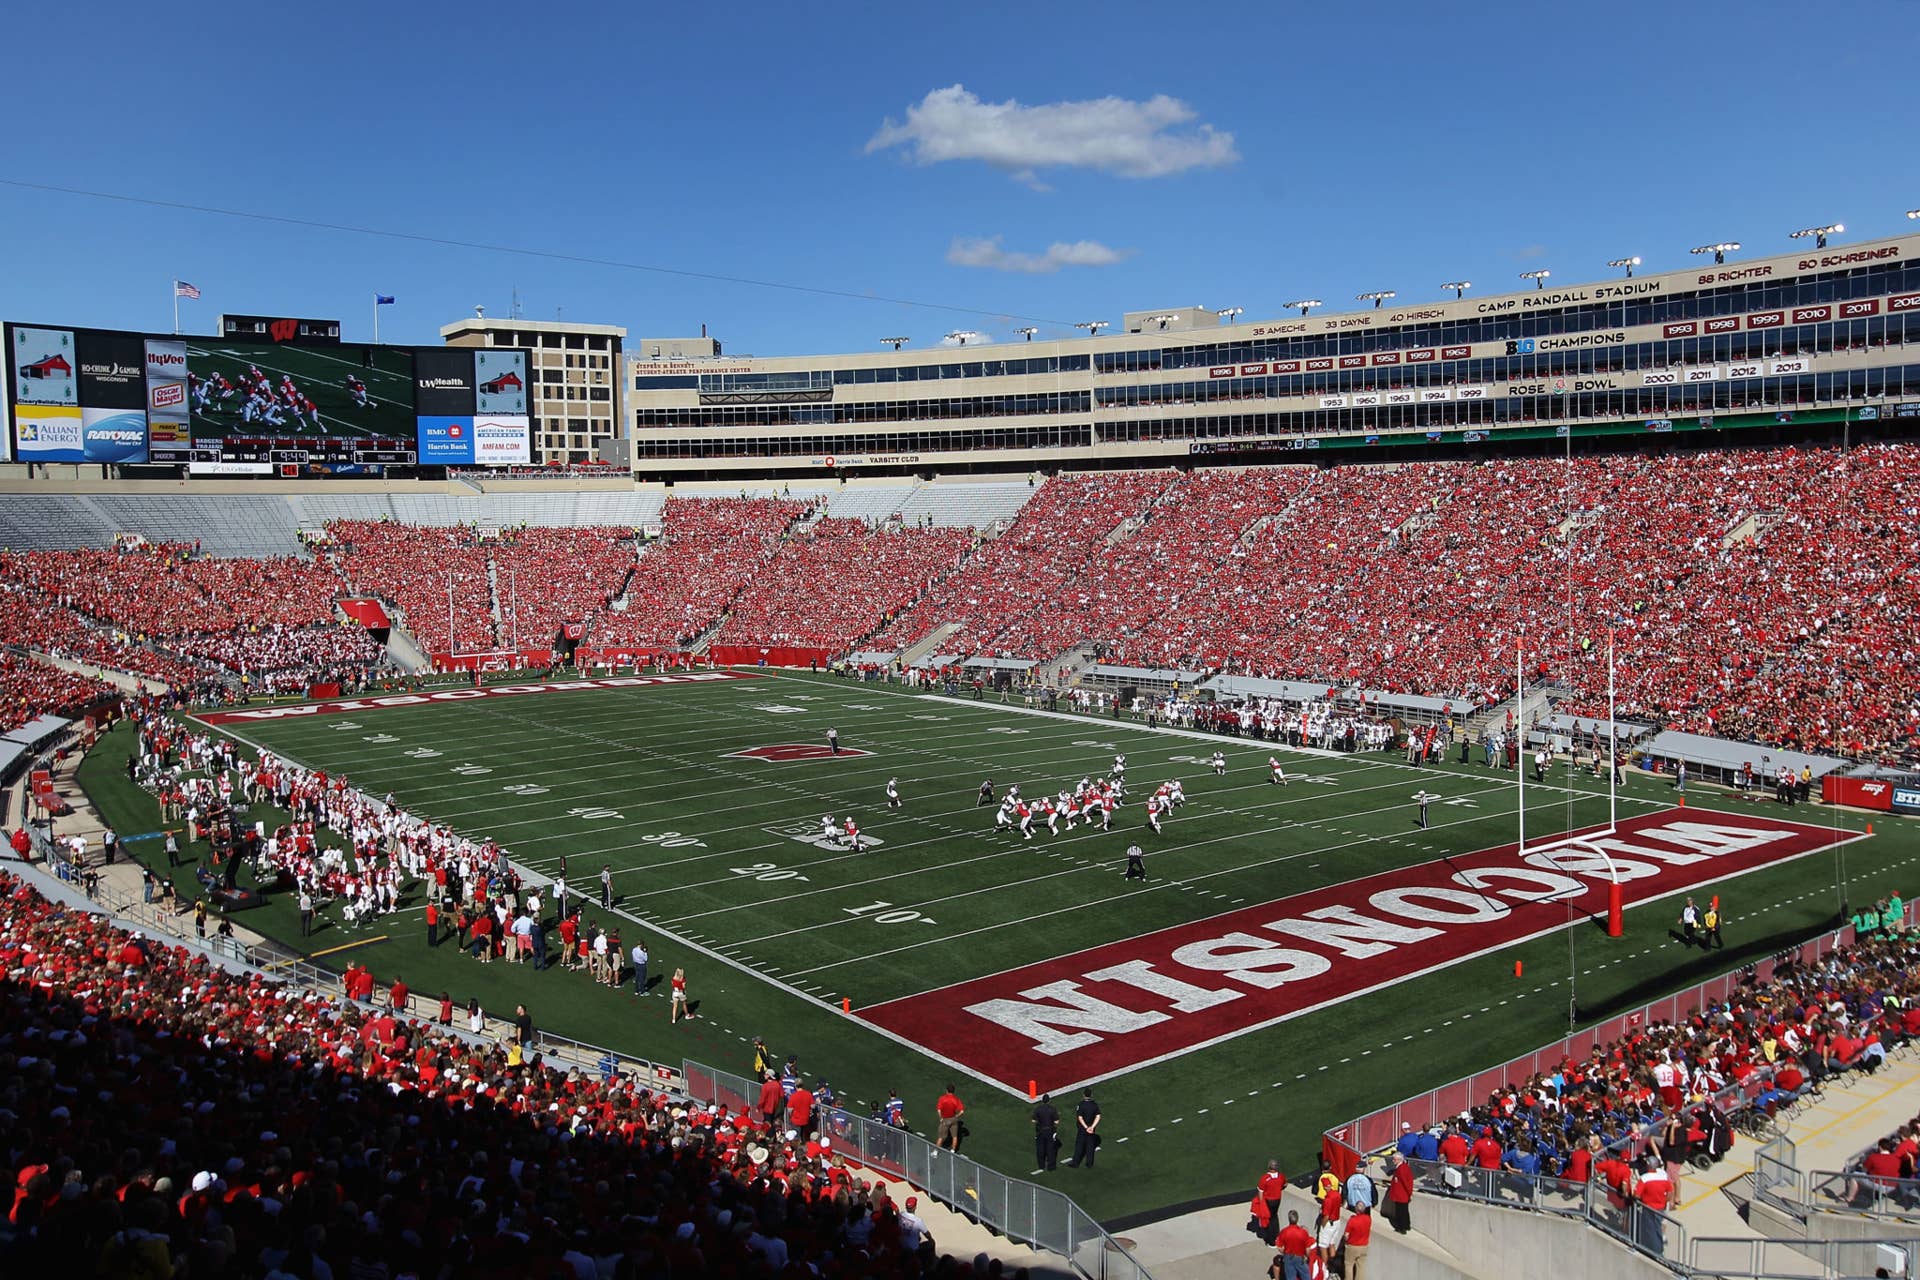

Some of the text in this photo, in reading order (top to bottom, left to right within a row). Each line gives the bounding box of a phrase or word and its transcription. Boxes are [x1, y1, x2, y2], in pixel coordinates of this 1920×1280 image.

[1821, 246, 1899, 267] SCHREINER
[1698, 265, 1773, 285] 88 RICHTER
[1478, 281, 1660, 313] CAMP RANDALL STADIUM
[1797, 308, 1827, 320] 2010
[1846, 303, 1872, 314] 2011
[1390, 309, 1445, 322] 40 HIRSCH
[1752, 314, 1780, 325] 1999
[1325, 316, 1371, 329] 33 DAYNE
[1252, 324, 1307, 336] 35 AMECHE
[1539, 332, 1626, 350] CHAMPIONS
[1445, 348, 1467, 357] 1962
[1309, 360, 1330, 369] 1906
[1343, 358, 1361, 366] 1912
[1776, 362, 1802, 373] 2013
[119, 366, 140, 375] GAMING
[1212, 368, 1233, 376] 1896
[1244, 366, 1264, 374] 1897
[1690, 371, 1711, 380] 2011
[1731, 367, 1757, 377] 2012
[1645, 374, 1675, 384] 2000
[157, 387, 179, 397] Oscar
[1460, 389, 1482, 397] 1999
[1509, 379, 1617, 396] ROSE BOWL
[156, 393, 180, 403] Mayer
[1355, 397, 1377, 405] 1960
[1390, 394, 1410, 402] 1963
[1424, 392, 1446, 400] 1994
[1323, 399, 1343, 407] 1953
[40, 425, 79, 435] ALLIANT
[87, 429, 144, 442] RAYOVAC
[427, 428, 446, 436] BMO
[41, 433, 79, 443] ENERGY
[280, 451, 306, 462] 9:44
[870, 456, 899, 464] VARSITY
[226, 673, 739, 718] WISCONSIN
[566, 806, 619, 820] 40
[641, 831, 699, 848] 30
[729, 862, 799, 882] 20
[842, 900, 922, 924] 10
[962, 820, 1798, 1057] WISCONSIN
[1661, 1072, 1674, 1083] 12
